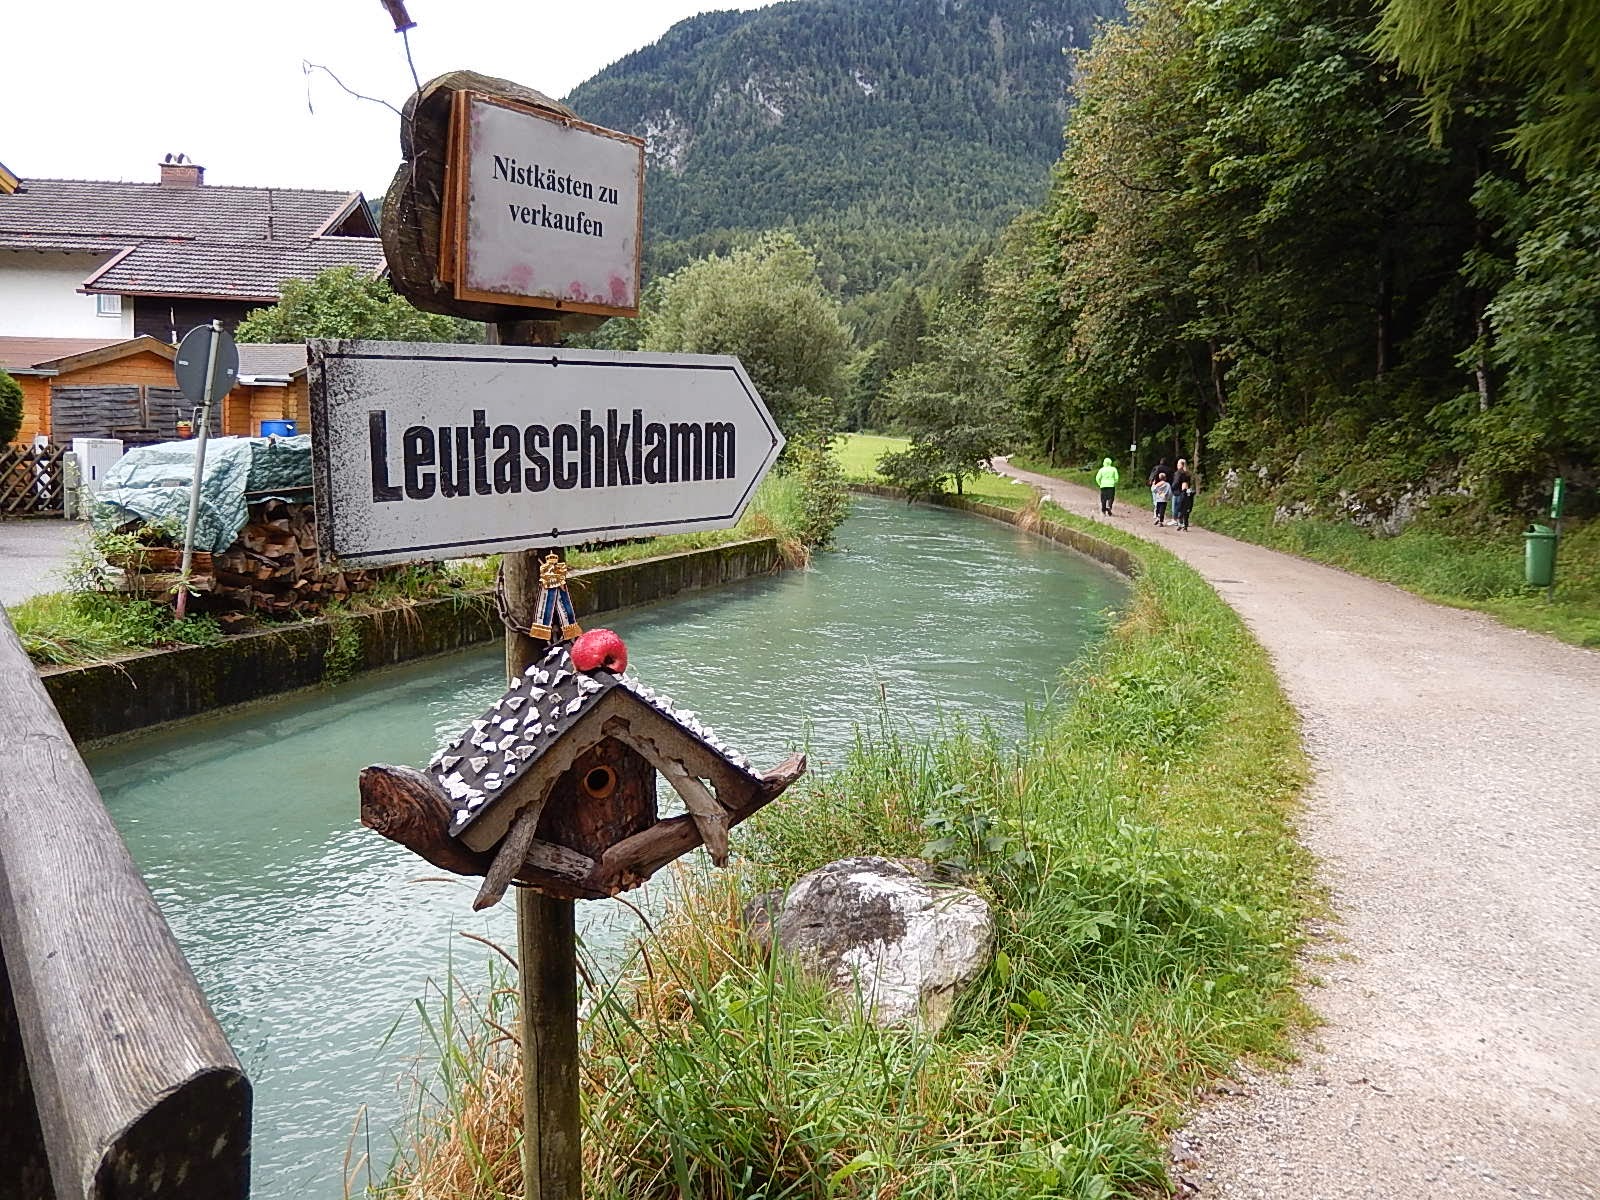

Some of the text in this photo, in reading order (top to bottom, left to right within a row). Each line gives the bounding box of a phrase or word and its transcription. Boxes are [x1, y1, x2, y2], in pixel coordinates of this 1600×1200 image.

[493, 155, 619, 205] Nistkästen zu
[509, 203, 603, 237] verkaufen
[369, 409, 736, 503] Leutaschklamm
